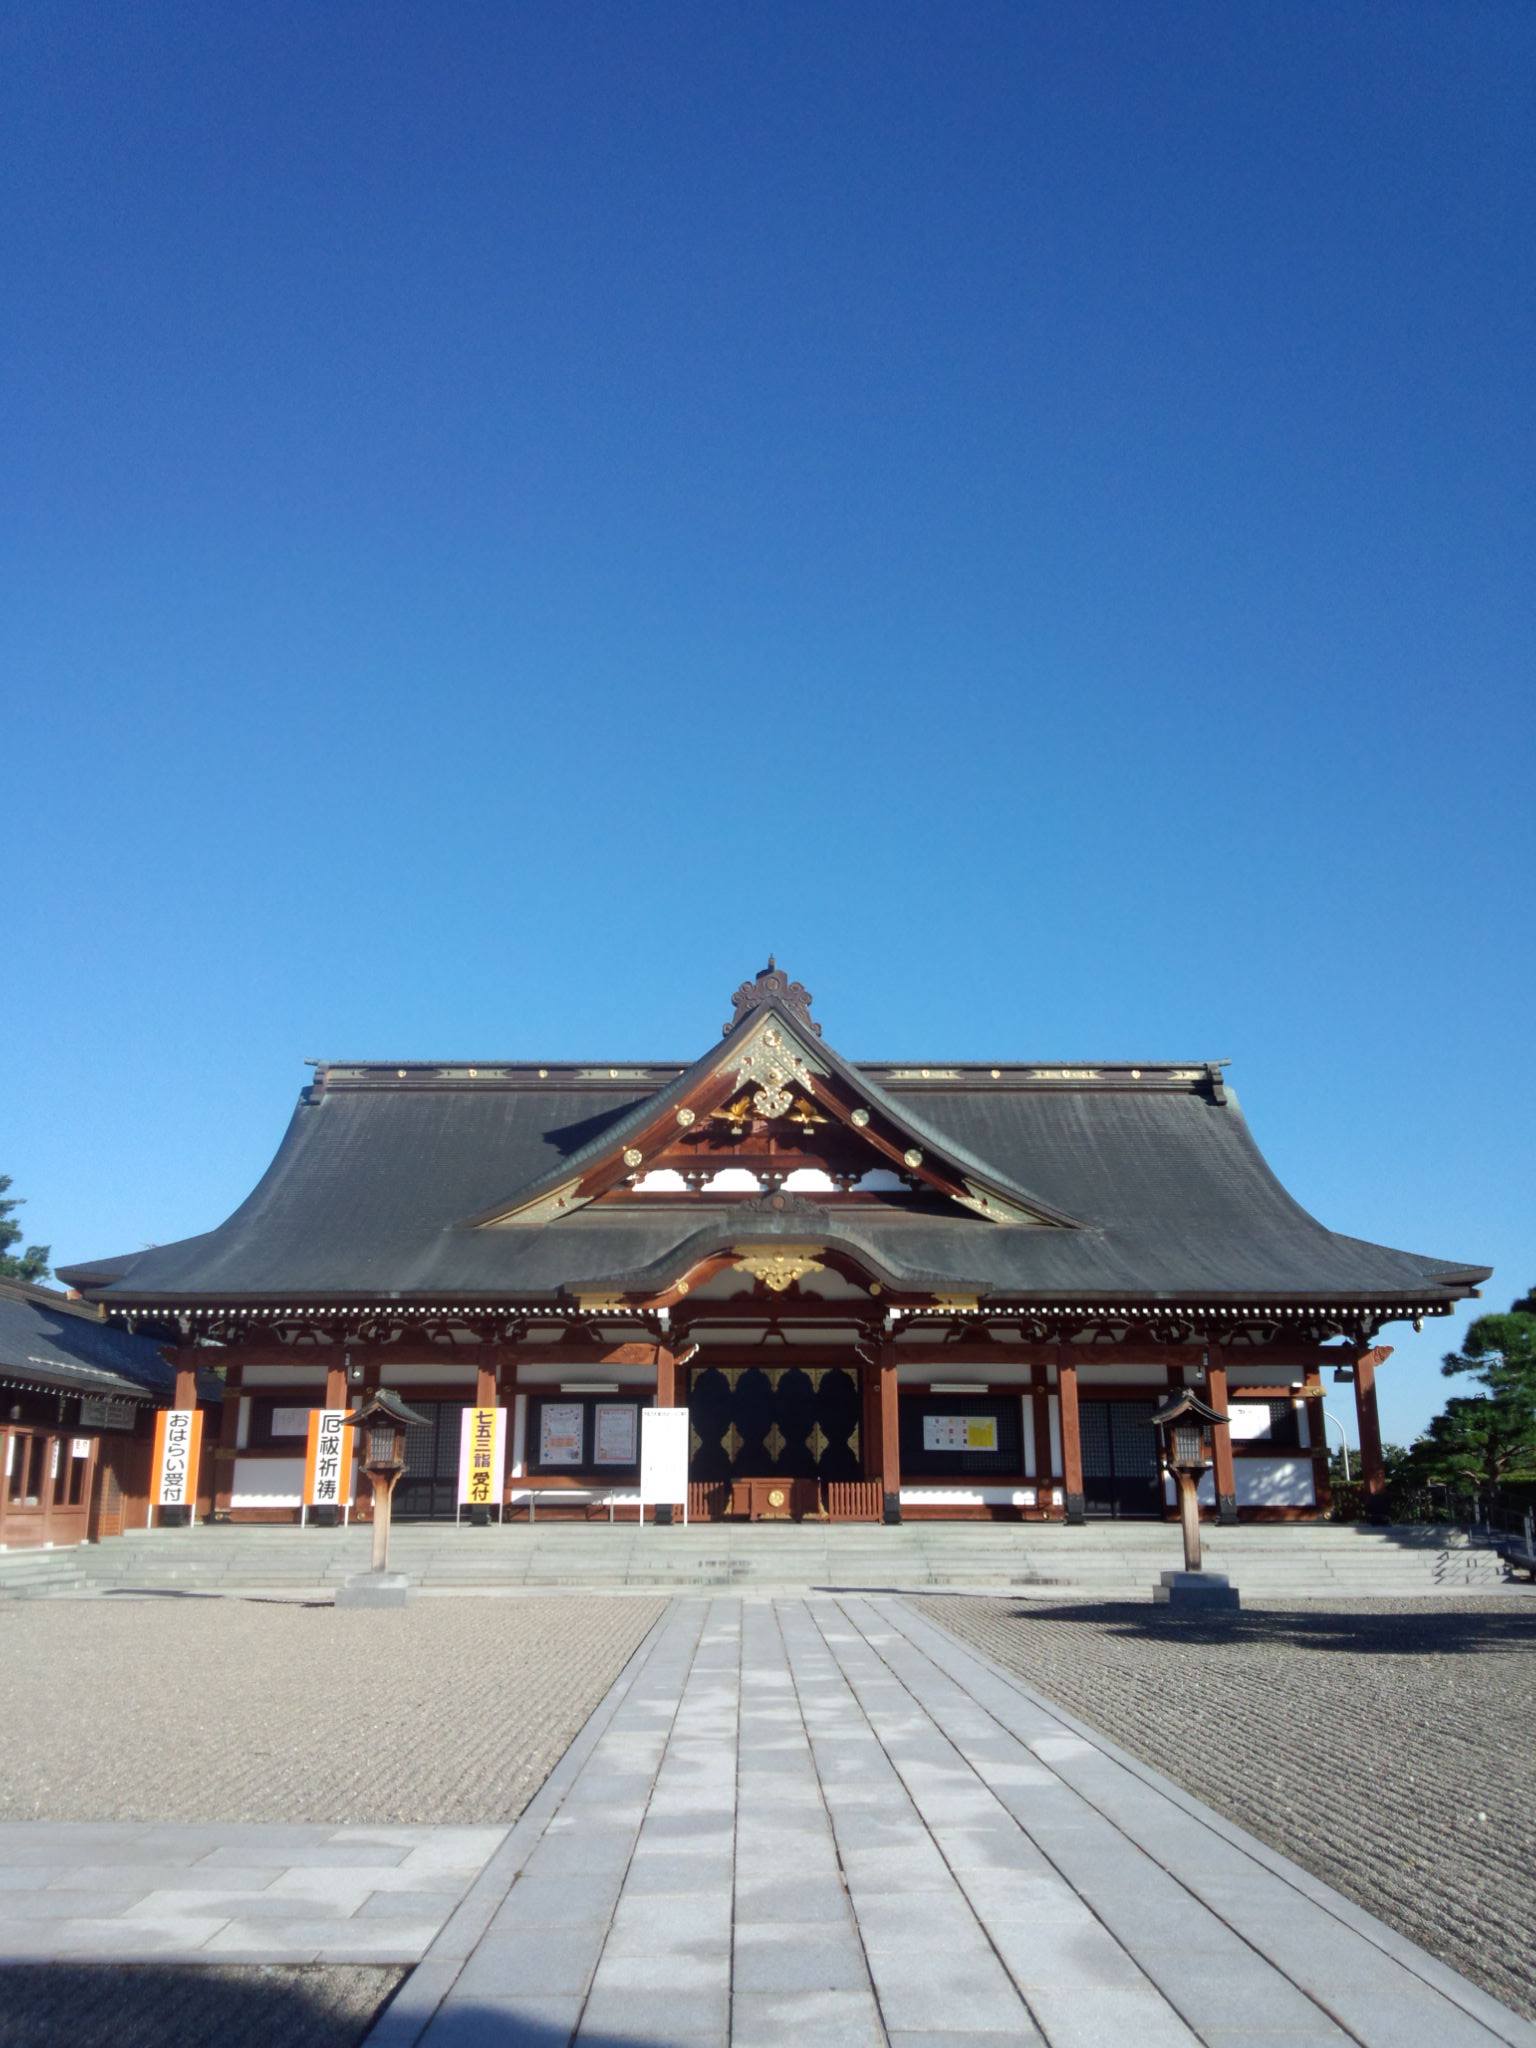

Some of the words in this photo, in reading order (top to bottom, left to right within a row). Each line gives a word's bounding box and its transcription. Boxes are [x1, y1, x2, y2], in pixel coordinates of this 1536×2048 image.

[163, 1414, 189, 1502] おはらい受付
[317, 1414, 342, 1500] 厄祓祈祷
